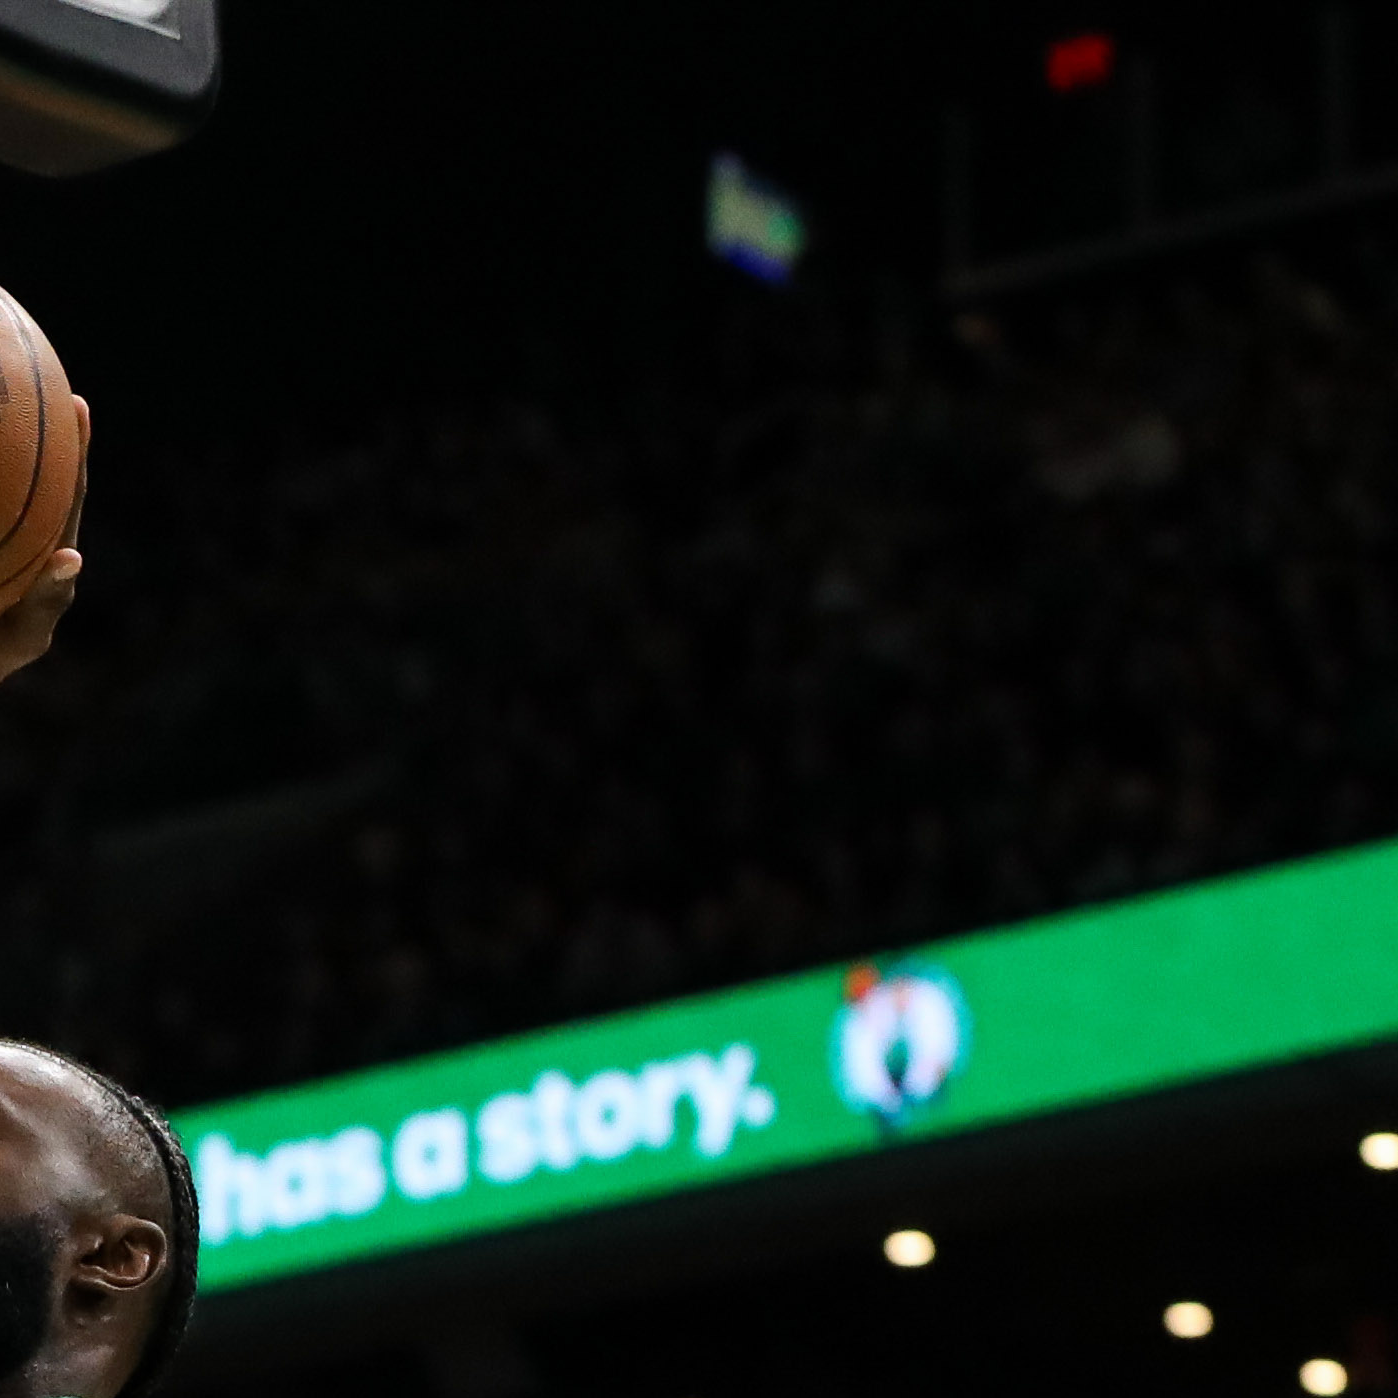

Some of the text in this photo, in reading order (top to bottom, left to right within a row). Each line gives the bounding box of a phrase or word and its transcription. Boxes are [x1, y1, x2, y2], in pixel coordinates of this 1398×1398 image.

[199, 1043, 777, 1246] has a story.
